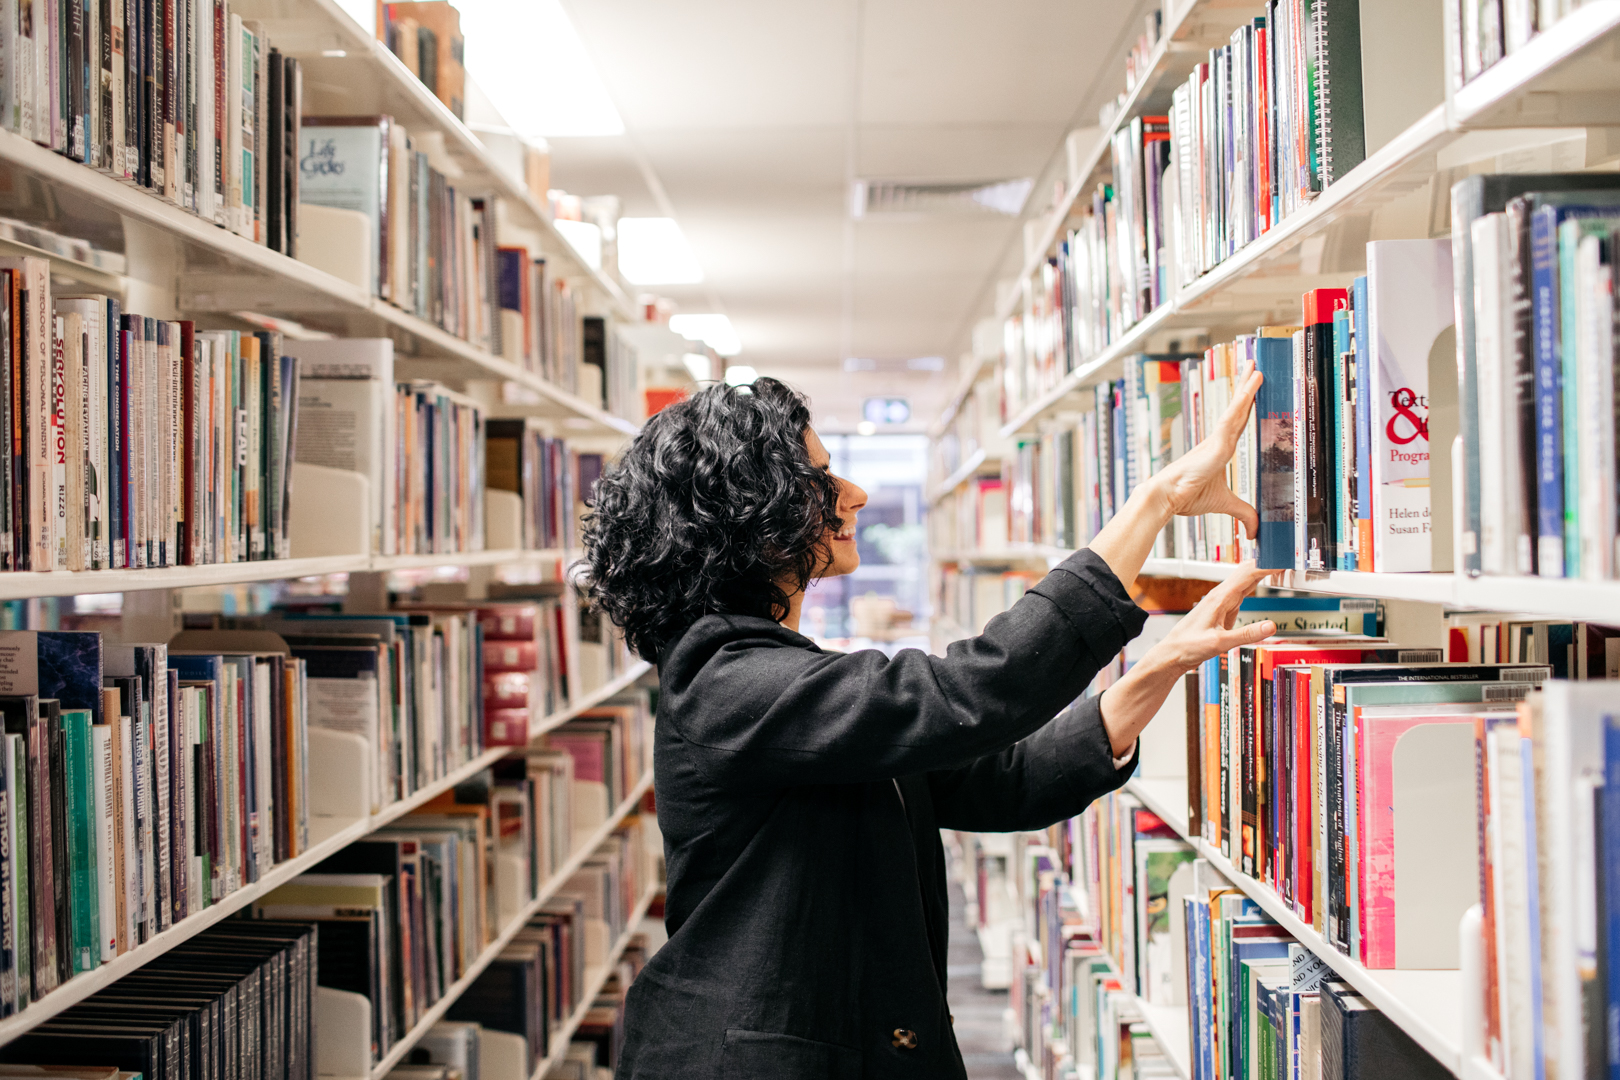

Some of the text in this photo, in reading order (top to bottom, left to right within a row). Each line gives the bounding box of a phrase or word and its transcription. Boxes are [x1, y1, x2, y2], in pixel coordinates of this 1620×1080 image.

[216, 64, 220, 76] ON
[39, 272, 45, 280] A
[40, 342, 46, 356] OF
[56, 338, 66, 464] SERVOLUTION
[1388, 391, 1430, 409] Text-
[1268, 411, 1279, 419] IN
[238, 409, 248, 467] LEAD
[2, 446, 12, 480] Sport
[1390, 448, 1430, 468] Progra
[1238, 450, 1247, 494] ADVISOR
[1388, 508, 1420, 522] Helen
[1388, 523, 1416, 538] Susan
[1294, 616, 1349, 632] Started
[1226, 756, 1230, 770] of
[136, 764, 146, 819] MENTORING
[158, 694, 170, 874] PENTECOSTAL PASTOR
[1248, 784, 1254, 796] of
[1338, 818, 1343, 828] of
[0, 790, 12, 951] METHOD IN MINISTRY
